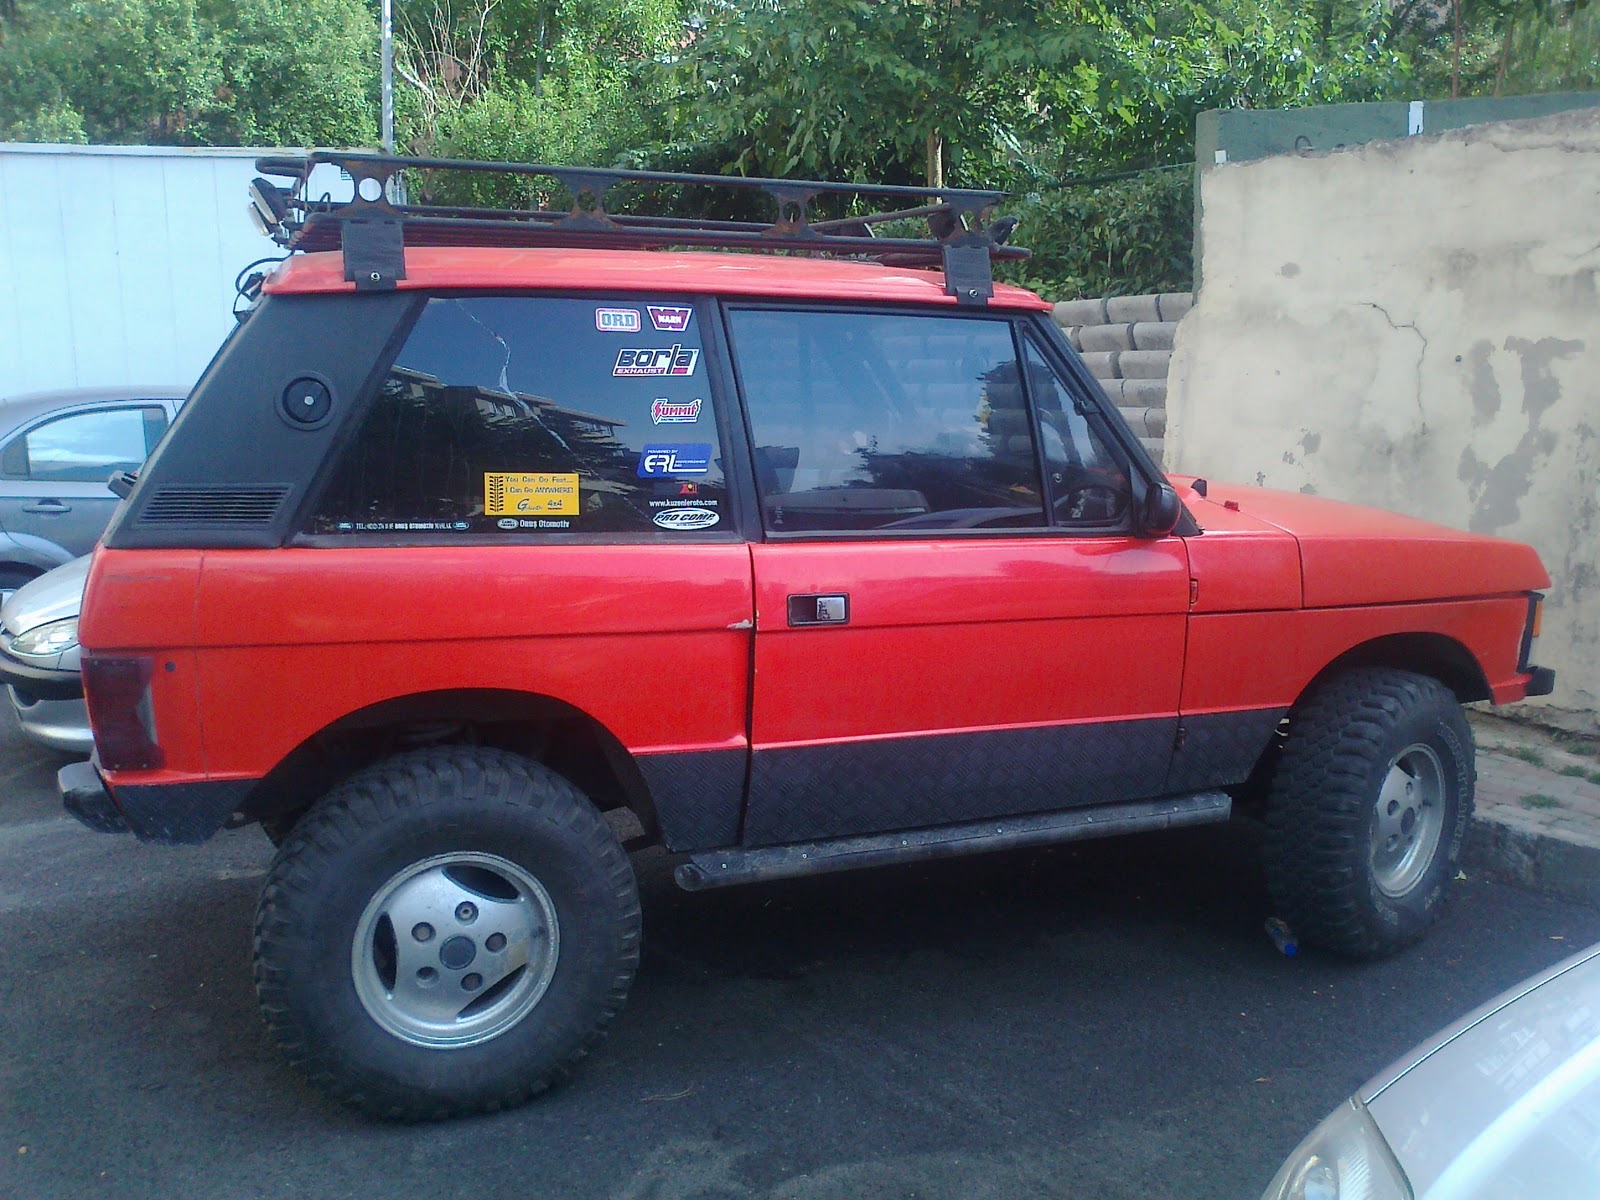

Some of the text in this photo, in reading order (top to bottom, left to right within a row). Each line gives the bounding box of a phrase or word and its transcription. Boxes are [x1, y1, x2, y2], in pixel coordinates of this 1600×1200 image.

[602, 313, 635, 327] ORD
[616, 367, 664, 375] EXHAUST
[654, 514, 679, 522] PRO
